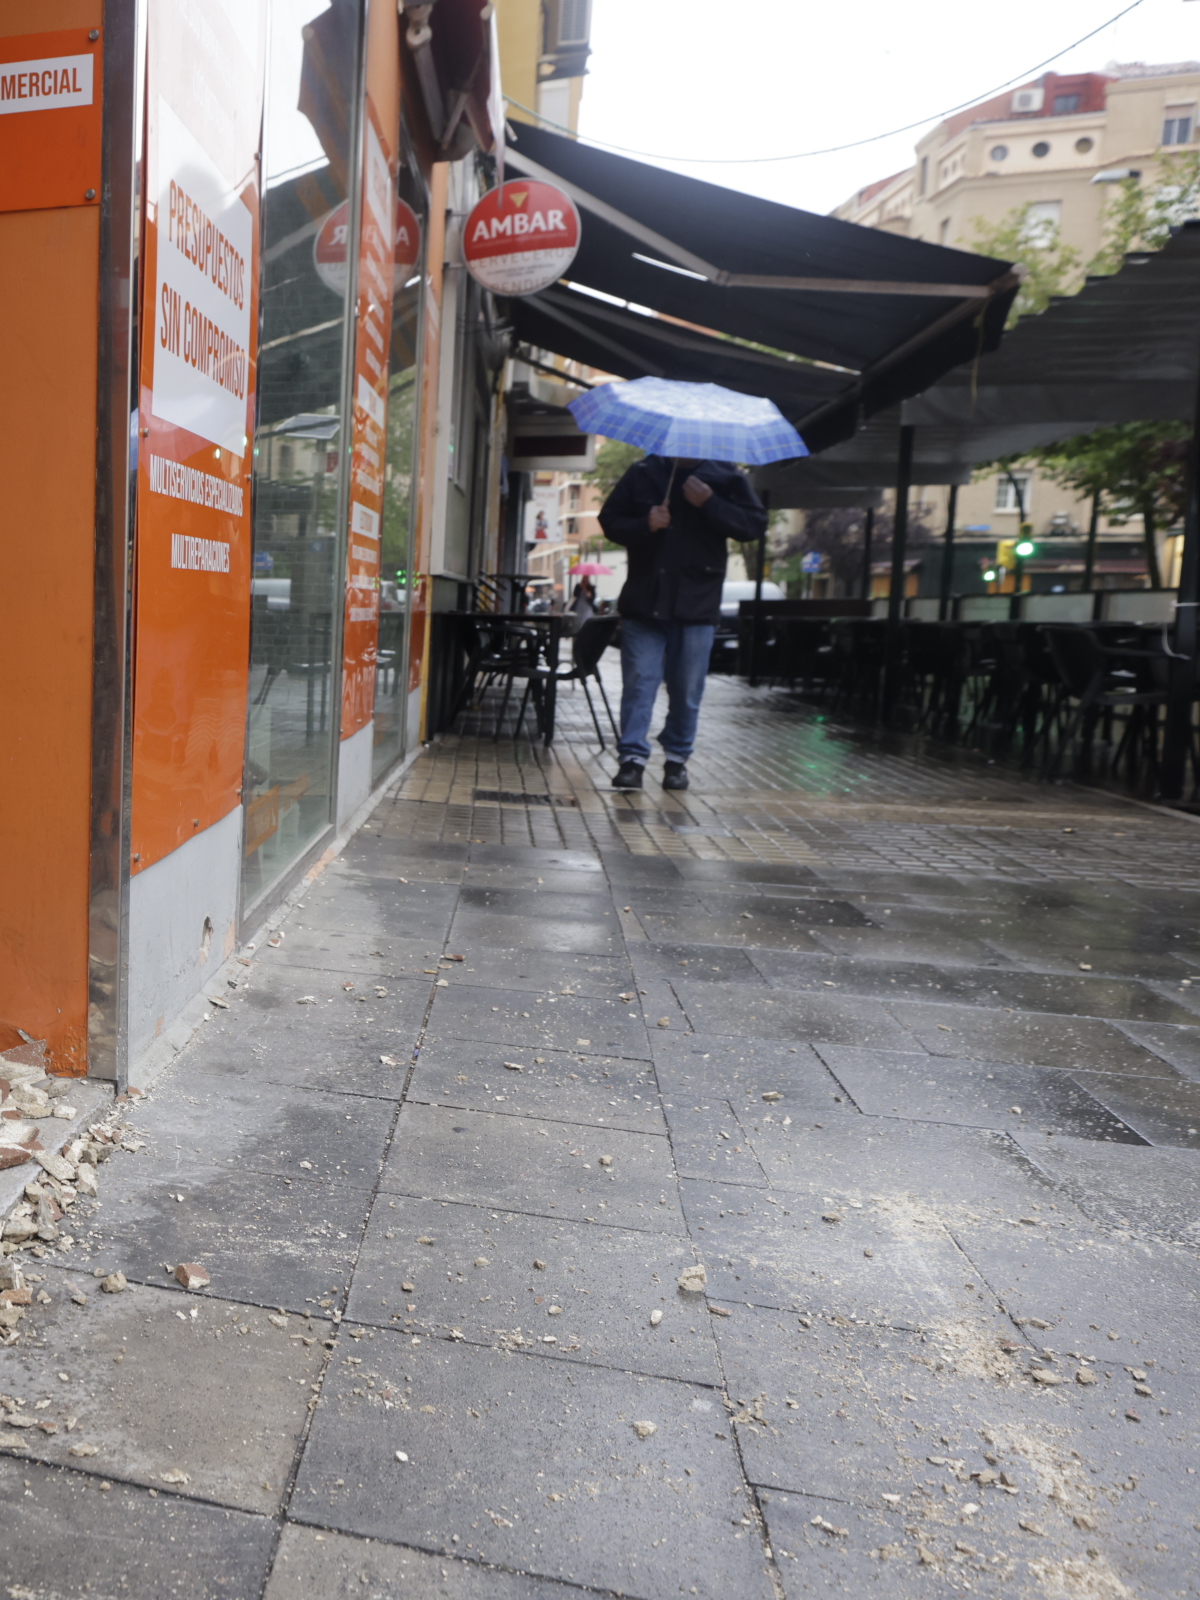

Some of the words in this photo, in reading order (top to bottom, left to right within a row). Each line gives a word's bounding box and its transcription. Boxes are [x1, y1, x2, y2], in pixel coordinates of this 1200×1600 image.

[169, 179, 245, 311] PRESUPUESTOS
[472, 209, 567, 242] AMBAR
[160, 282, 181, 357] SIN
[184, 301, 245, 400] COMPROMISO
[150, 453, 204, 505] MULTISERVICIOS
[205, 470, 243, 517] ESPECIALIZADOS
[171, 533, 230, 573] MULTIREPARACIONES
